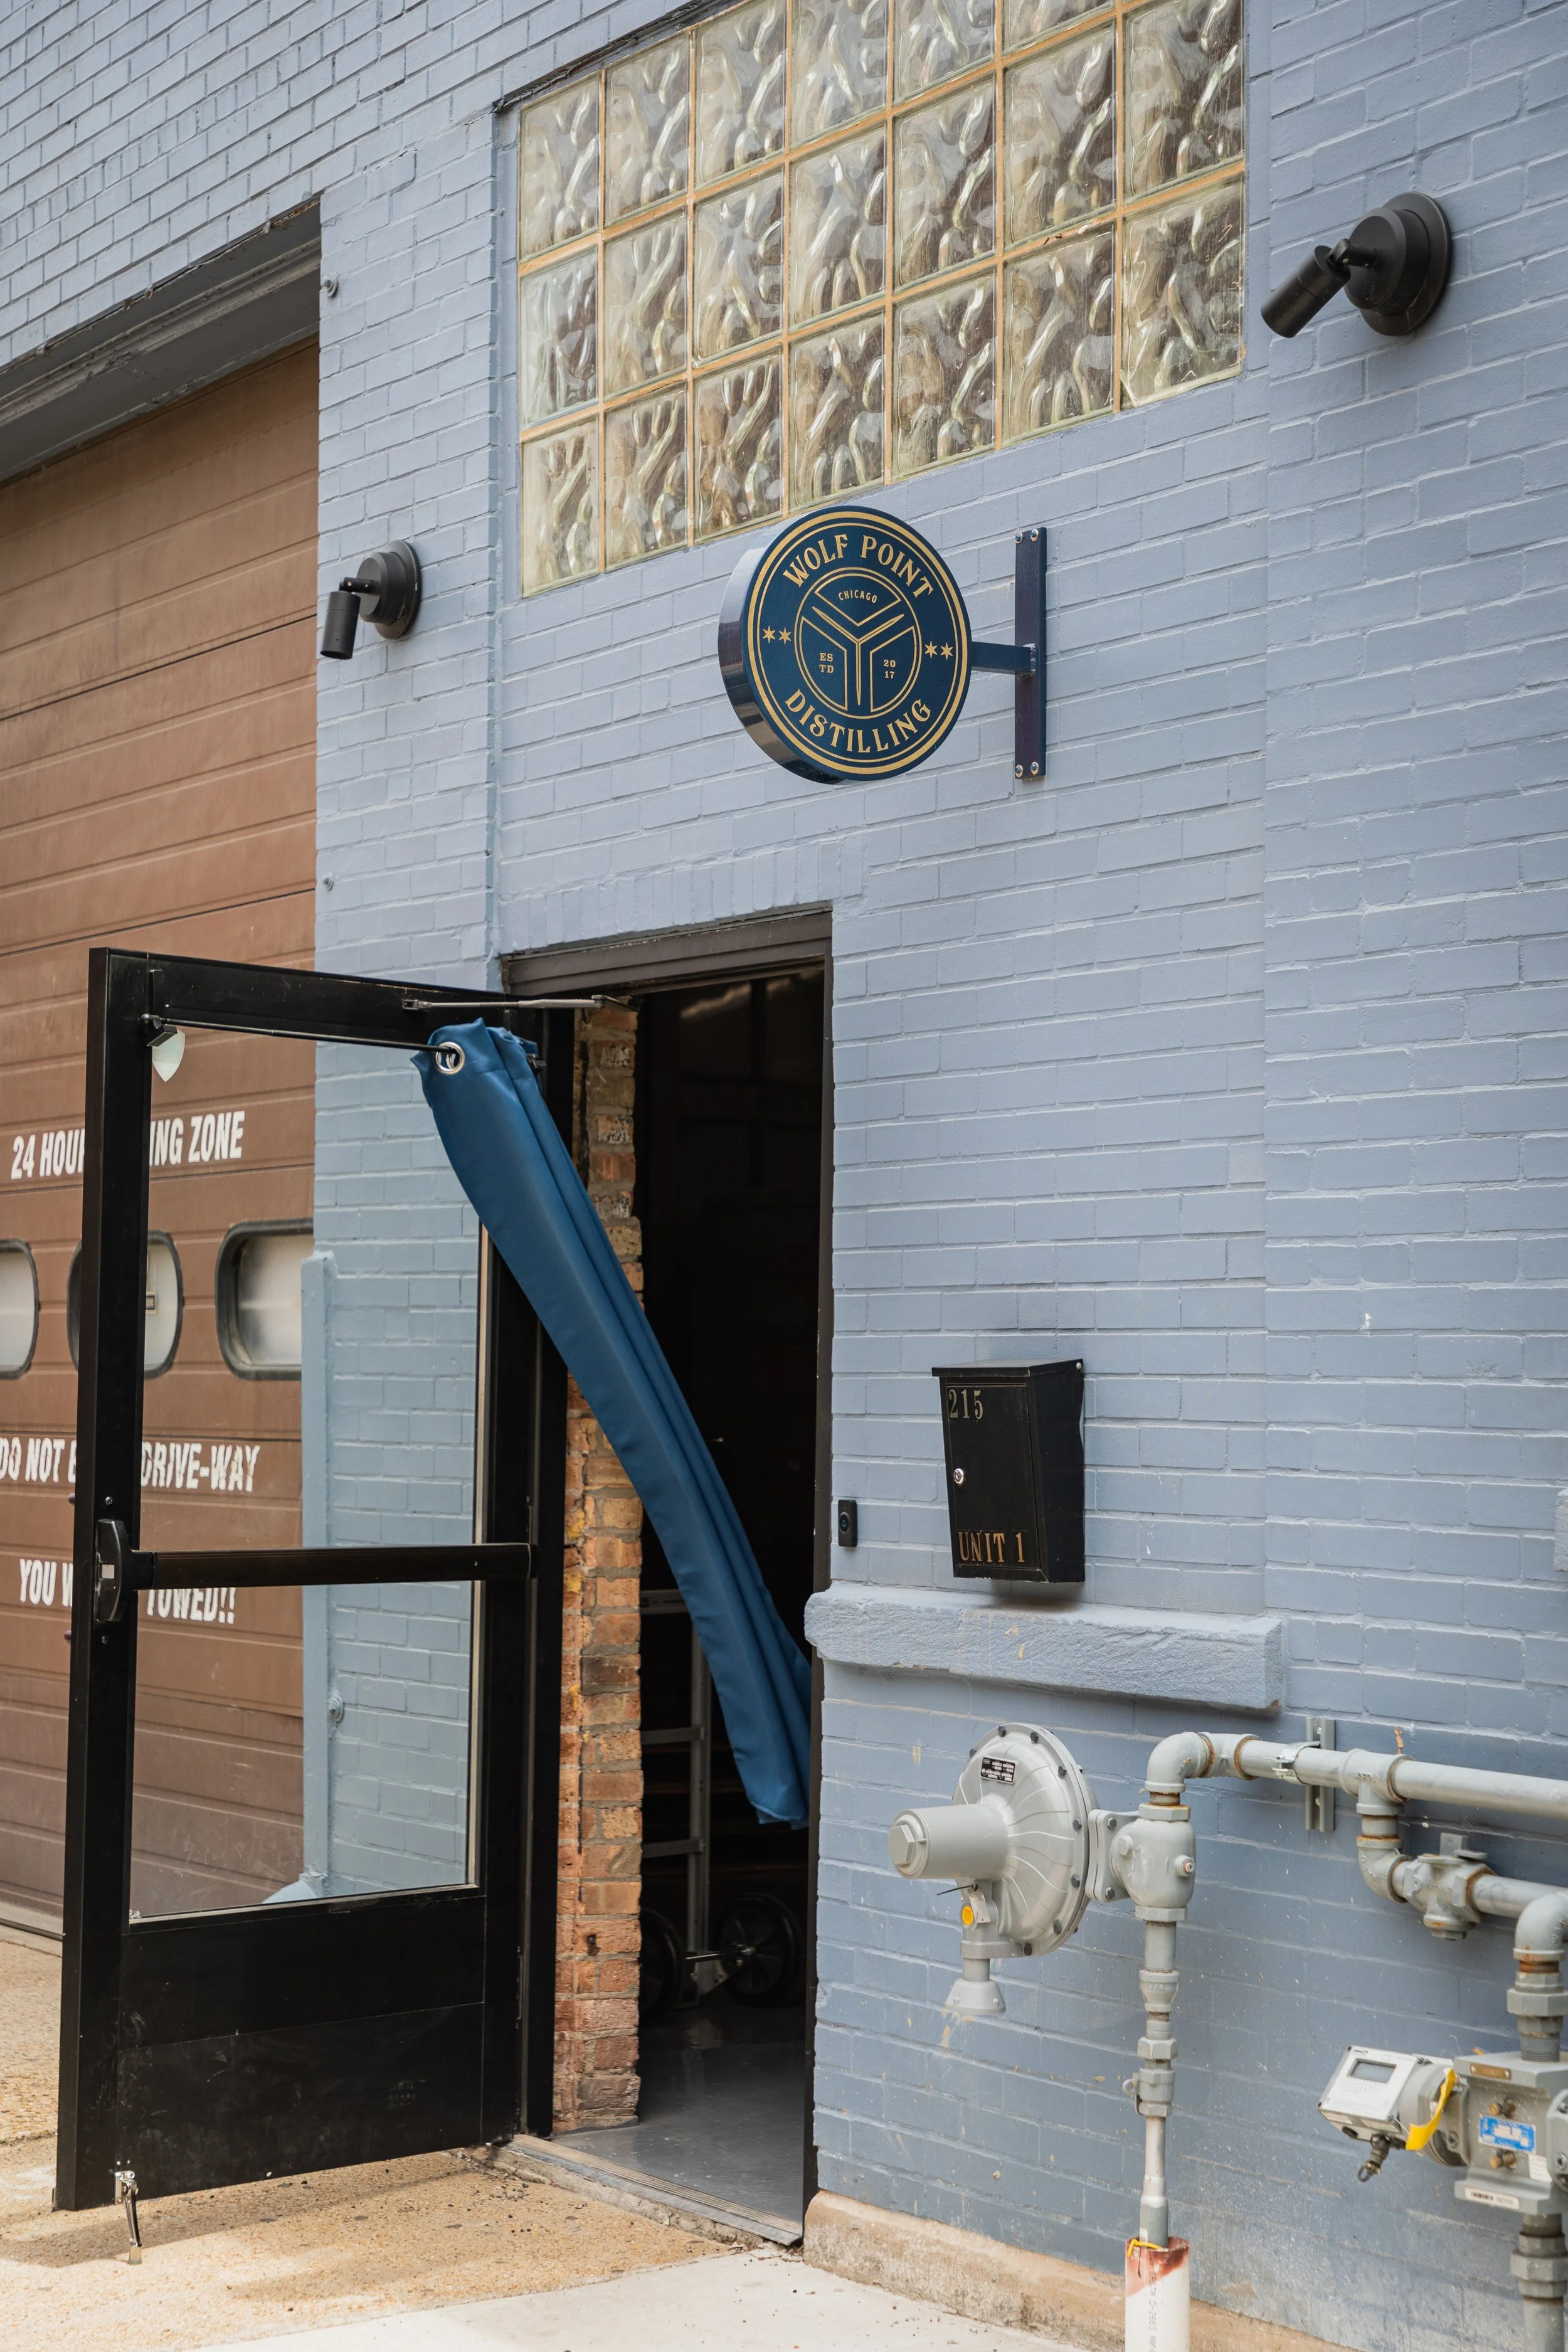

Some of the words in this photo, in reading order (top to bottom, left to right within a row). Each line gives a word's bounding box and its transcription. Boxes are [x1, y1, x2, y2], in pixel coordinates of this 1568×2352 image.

[783, 534, 848, 587] WOLF
[861, 535, 933, 598] POINT
[839, 590, 877, 603] CHICAGO
[819, 652, 834, 662] ES
[819, 664, 834, 674] TD
[883, 659, 896, 667] 20
[884, 670, 895, 679] 17
[785, 689, 932, 753] DISTILLING
[11, 1135, 36, 1180] 24
[189, 1110, 245, 1163] ZONE
[948, 1389, 983, 1420] 215
[25, 1438, 65, 1483] NOT
[141, 1441, 261, 1491] DRIVE-WAY
[958, 1532, 1005, 1563] UNIT
[1015, 1532, 1025, 1563] 1
[20, 1559, 57, 1606] YOU
